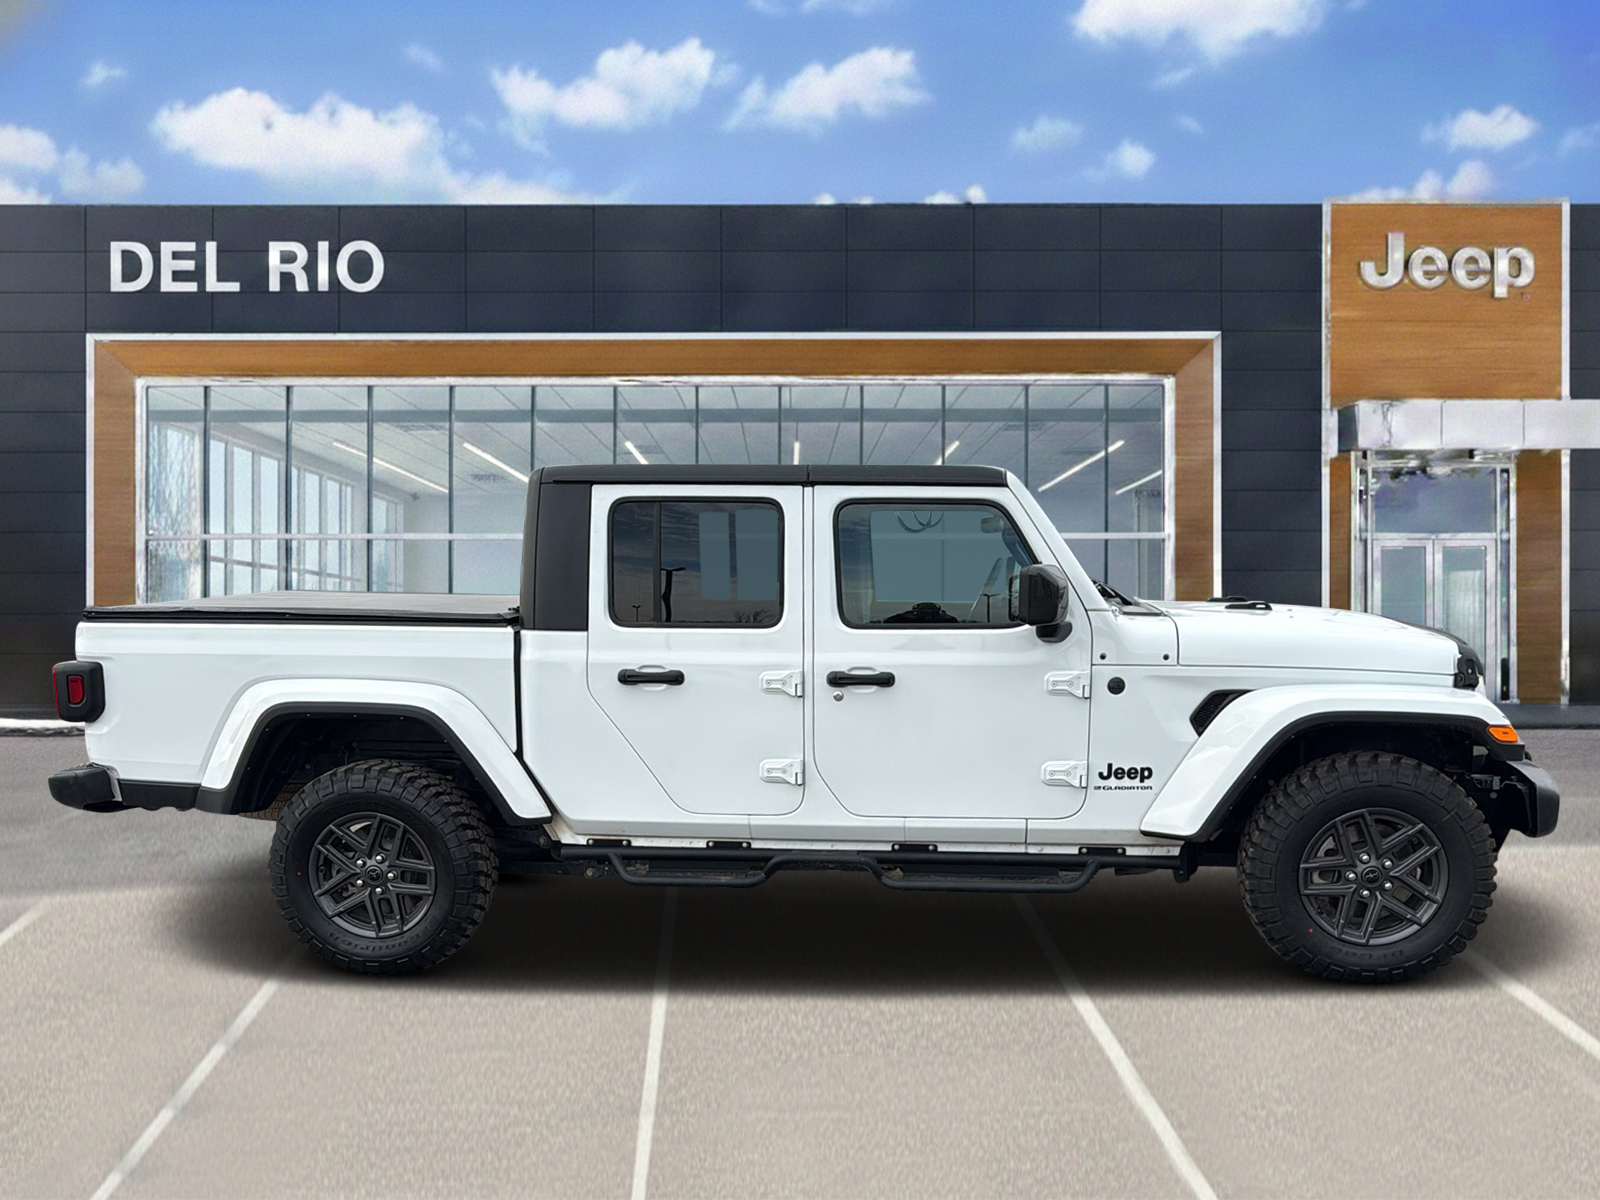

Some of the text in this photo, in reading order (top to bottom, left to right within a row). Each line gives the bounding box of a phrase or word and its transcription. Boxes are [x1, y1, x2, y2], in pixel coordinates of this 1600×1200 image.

[110, 239, 384, 292] DEL RIO
[1360, 231, 1535, 298] Jeep
[1098, 763, 1153, 783] Jeep
